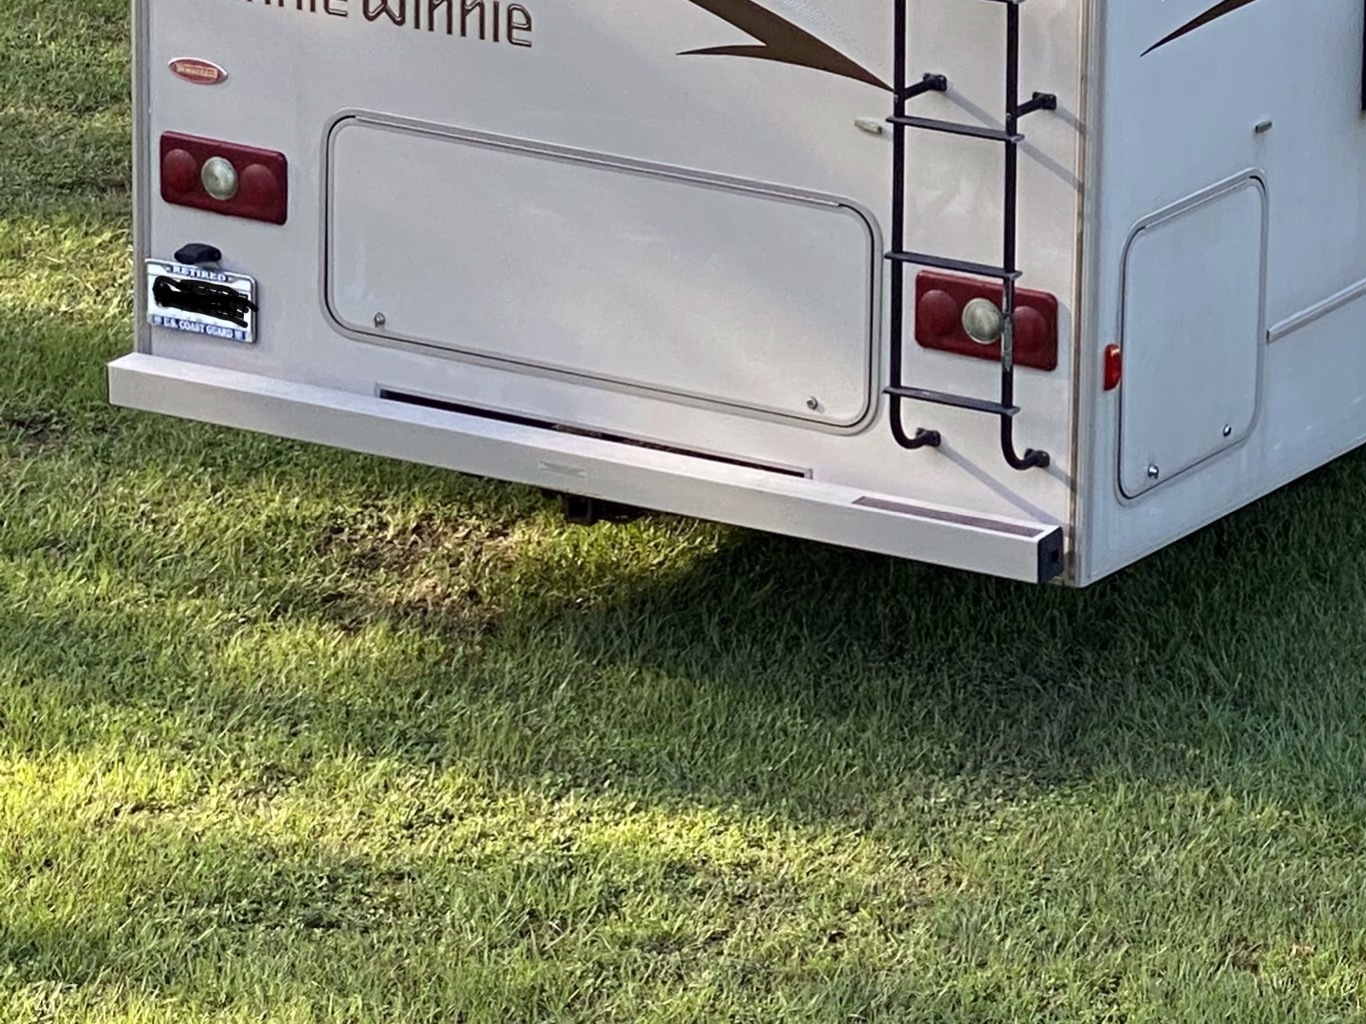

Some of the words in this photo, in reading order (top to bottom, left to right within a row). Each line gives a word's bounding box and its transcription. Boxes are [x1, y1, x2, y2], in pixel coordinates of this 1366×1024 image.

[172, 265, 227, 282] RETIRED
[179, 320, 205, 333] COAST
[205, 324, 234, 339] GUARD
